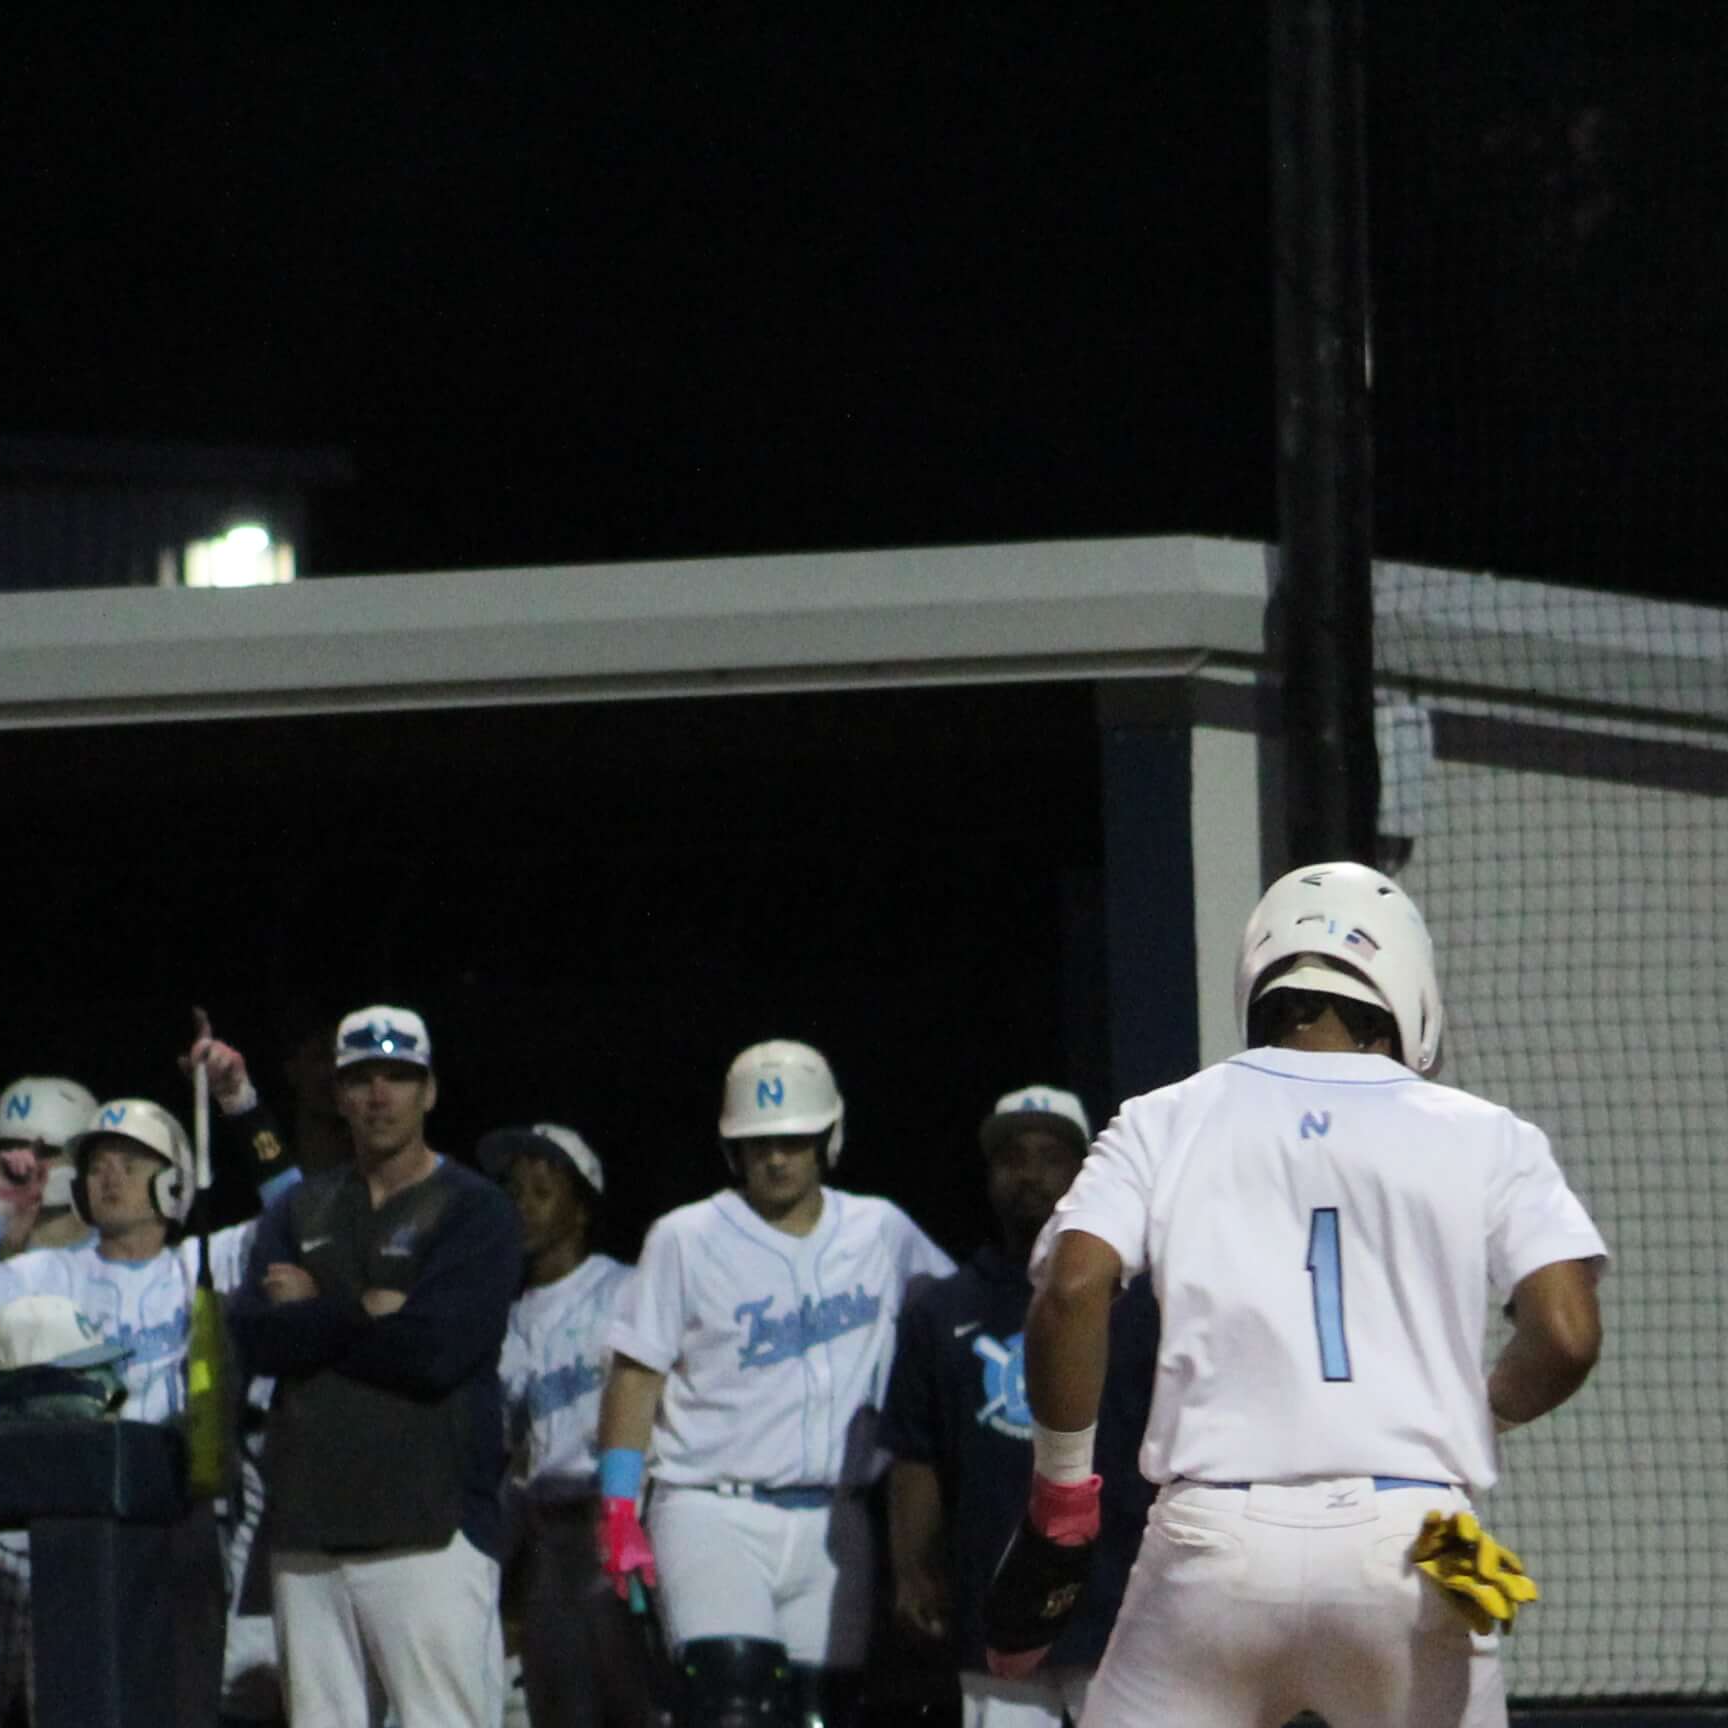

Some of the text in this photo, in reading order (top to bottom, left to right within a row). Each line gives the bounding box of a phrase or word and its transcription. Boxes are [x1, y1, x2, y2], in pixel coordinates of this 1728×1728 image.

[6, 1093, 32, 1121] N
[755, 1077, 785, 1110] N
[99, 1104, 126, 1129] N
[1299, 1110, 1332, 1139] N
[1305, 1206, 1354, 1383] 1
